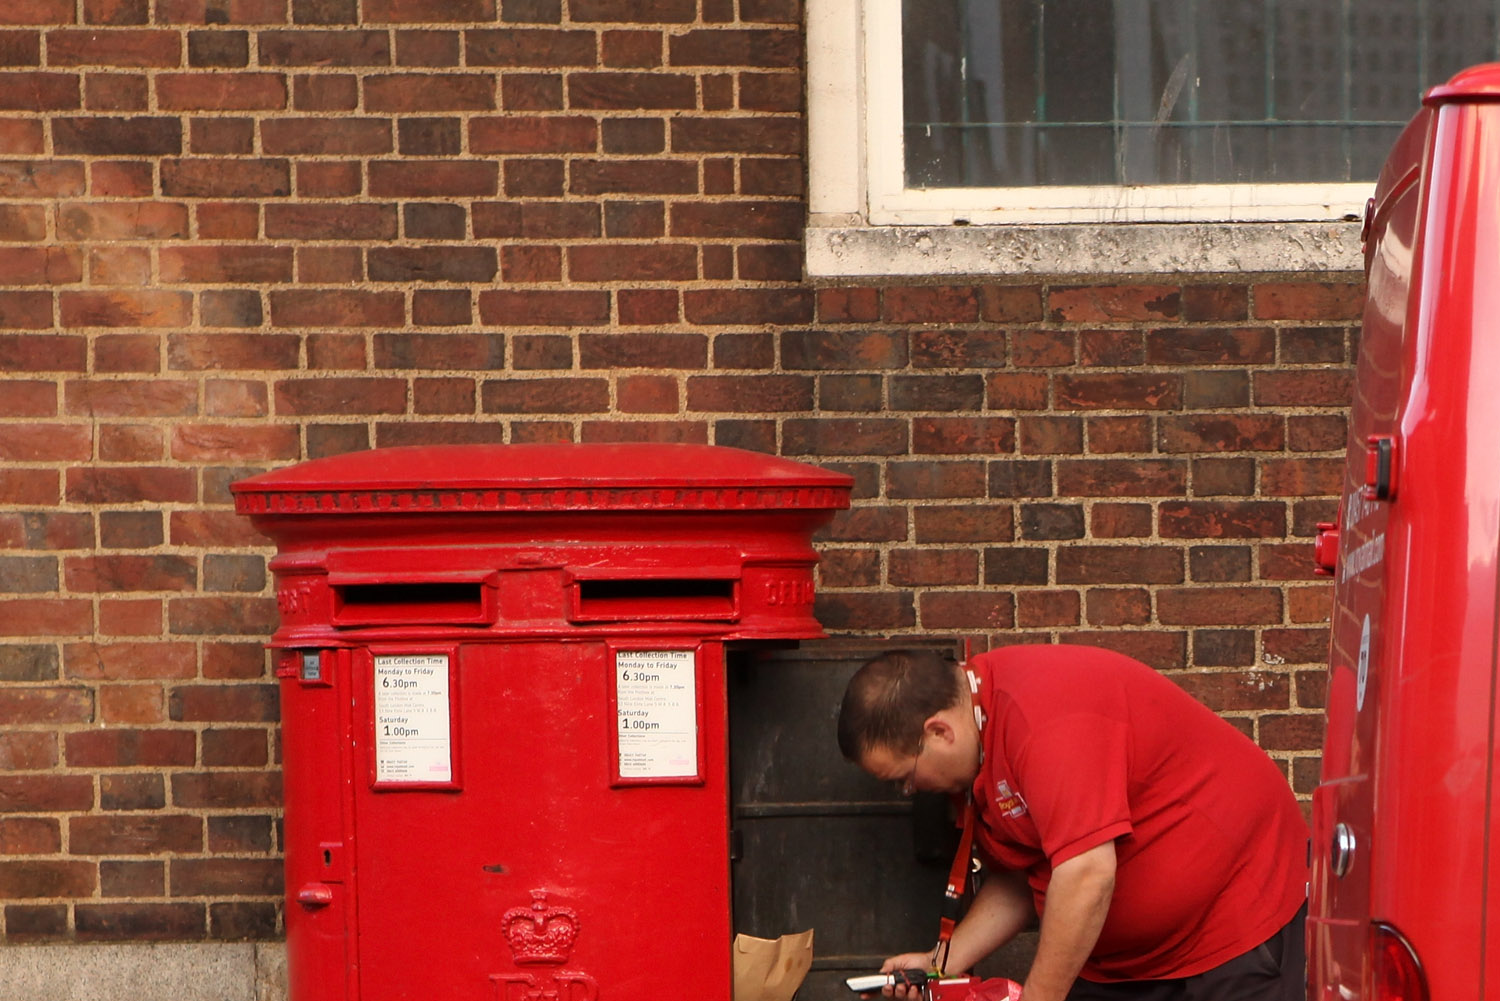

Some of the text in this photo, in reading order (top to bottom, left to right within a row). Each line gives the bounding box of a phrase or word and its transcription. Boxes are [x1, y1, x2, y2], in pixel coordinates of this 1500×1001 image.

[635, 651, 669, 659] Collection
[393, 657, 425, 665] Collection
[427, 657, 443, 665] Time
[618, 662, 645, 670] Monday
[656, 661, 678, 670] Friday
[378, 667, 404, 676] Monday
[413, 667, 434, 676] Friday
[622, 670, 660, 683] 6.30pm
[382, 676, 418, 689] 6.30pm
[617, 709, 649, 718] Saturday
[379, 716, 409, 724] Saturday
[622, 718, 660, 731] 1.00pm
[383, 725, 419, 738] 1.00pm
